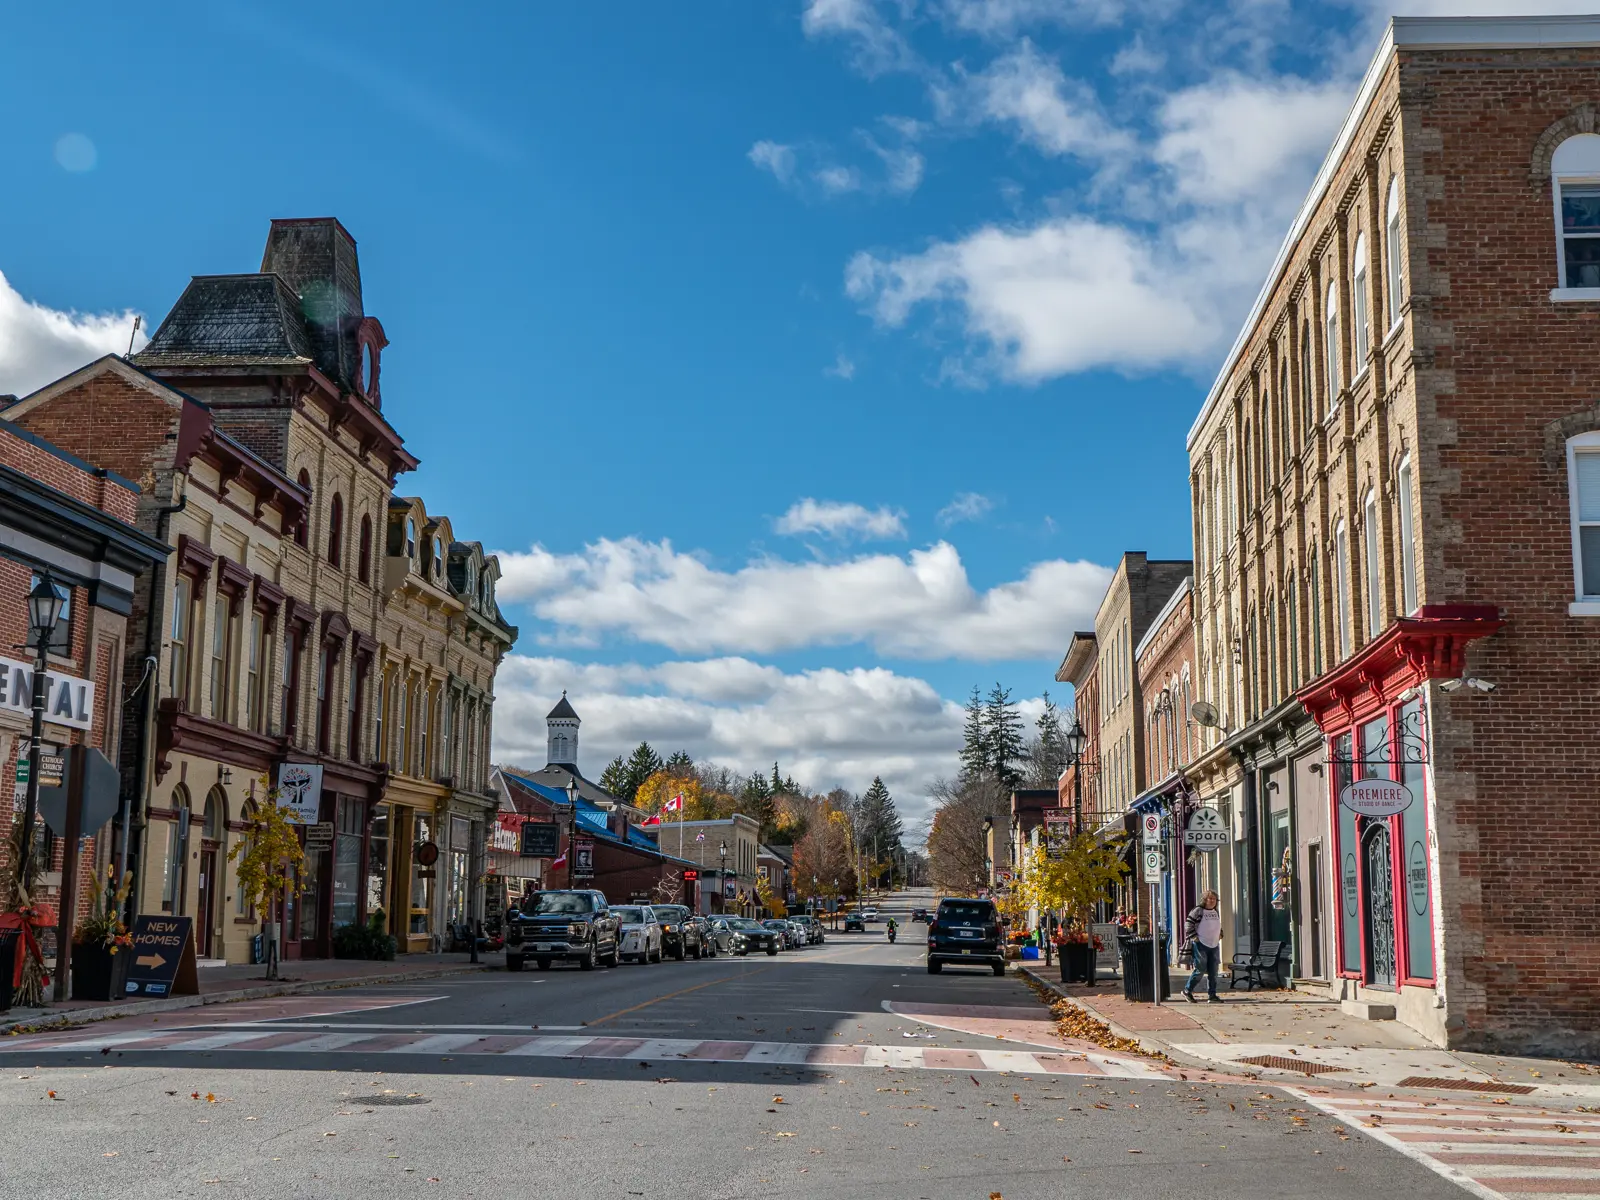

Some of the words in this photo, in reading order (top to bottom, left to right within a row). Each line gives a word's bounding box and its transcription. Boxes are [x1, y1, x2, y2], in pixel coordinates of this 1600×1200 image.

[41, 756, 64, 764] CATHOLIC
[42, 763, 62, 771] CHURCH
[1352, 788, 1402, 800] PREMIERE
[1188, 832, 1227, 843] sparq
[147, 922, 178, 932] NEW
[135, 934, 181, 946] HOMES
